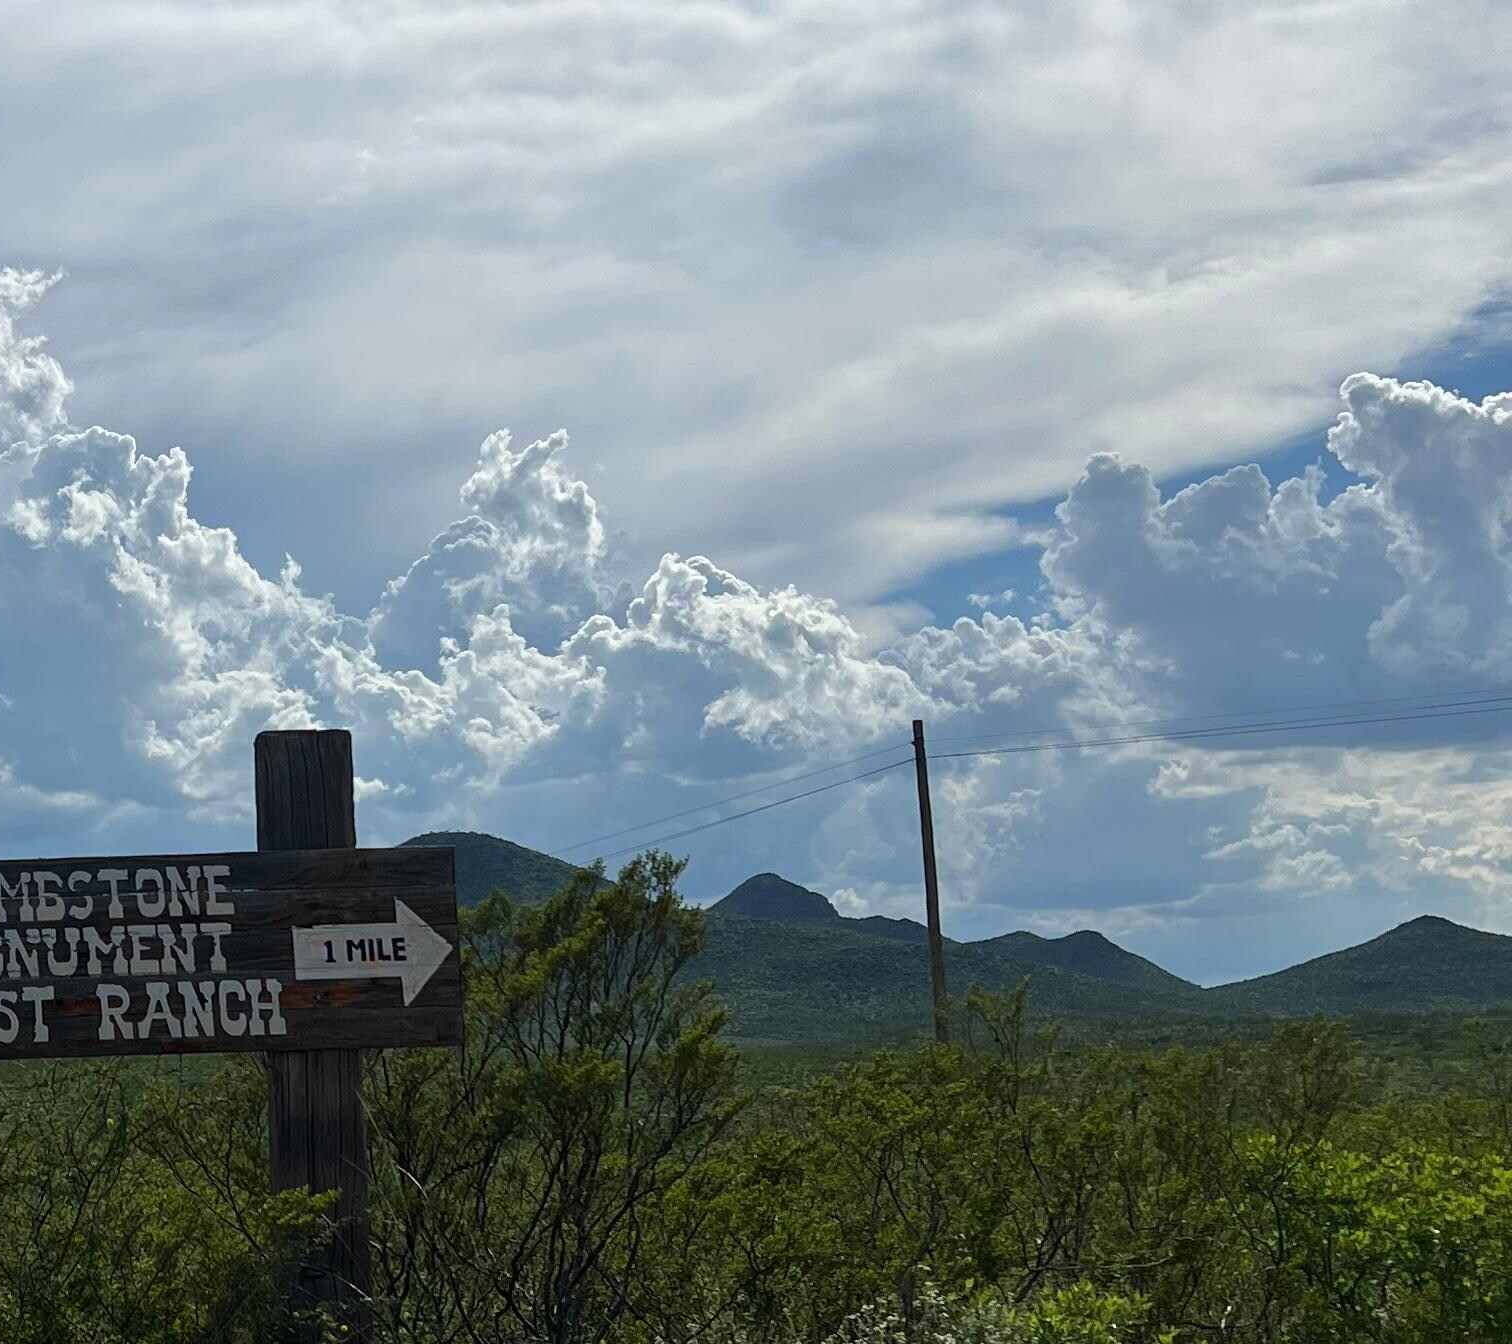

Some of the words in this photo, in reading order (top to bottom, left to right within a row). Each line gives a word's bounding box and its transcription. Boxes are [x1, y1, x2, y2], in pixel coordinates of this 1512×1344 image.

[324, 940, 336, 963] 1
[346, 937, 407, 962] MILE
[97, 978, 287, 1041] RANCH
